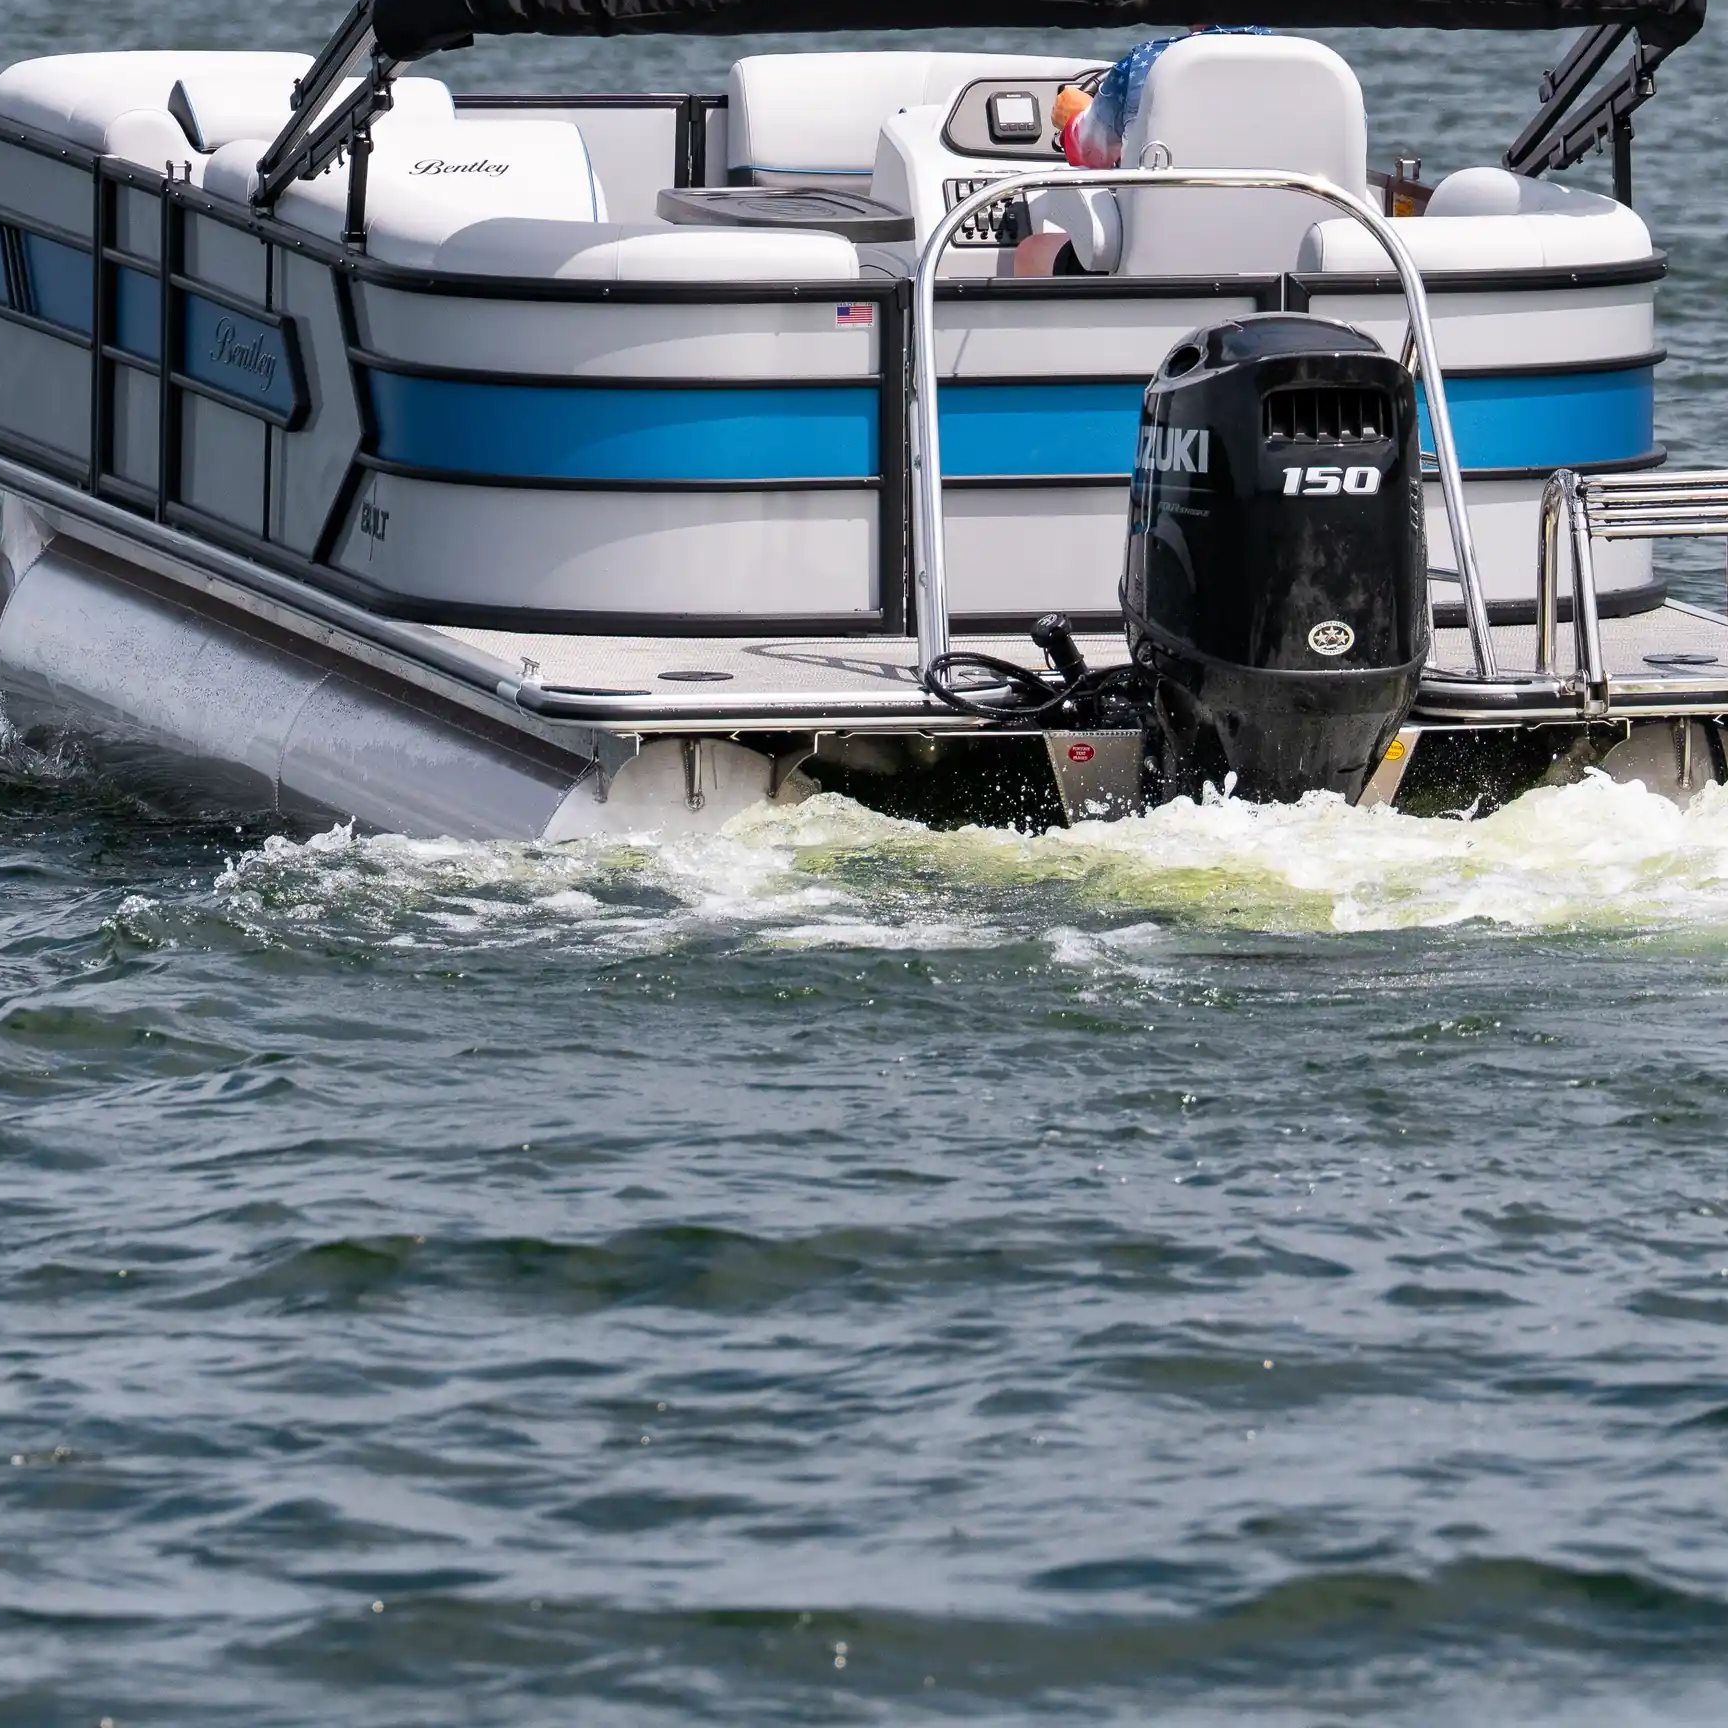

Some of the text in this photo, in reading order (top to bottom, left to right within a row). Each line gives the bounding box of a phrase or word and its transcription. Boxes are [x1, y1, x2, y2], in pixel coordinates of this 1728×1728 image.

[408, 158, 510, 178] Bentley
[209, 316, 277, 392] Bentley
[1282, 466, 1382, 496] 150
